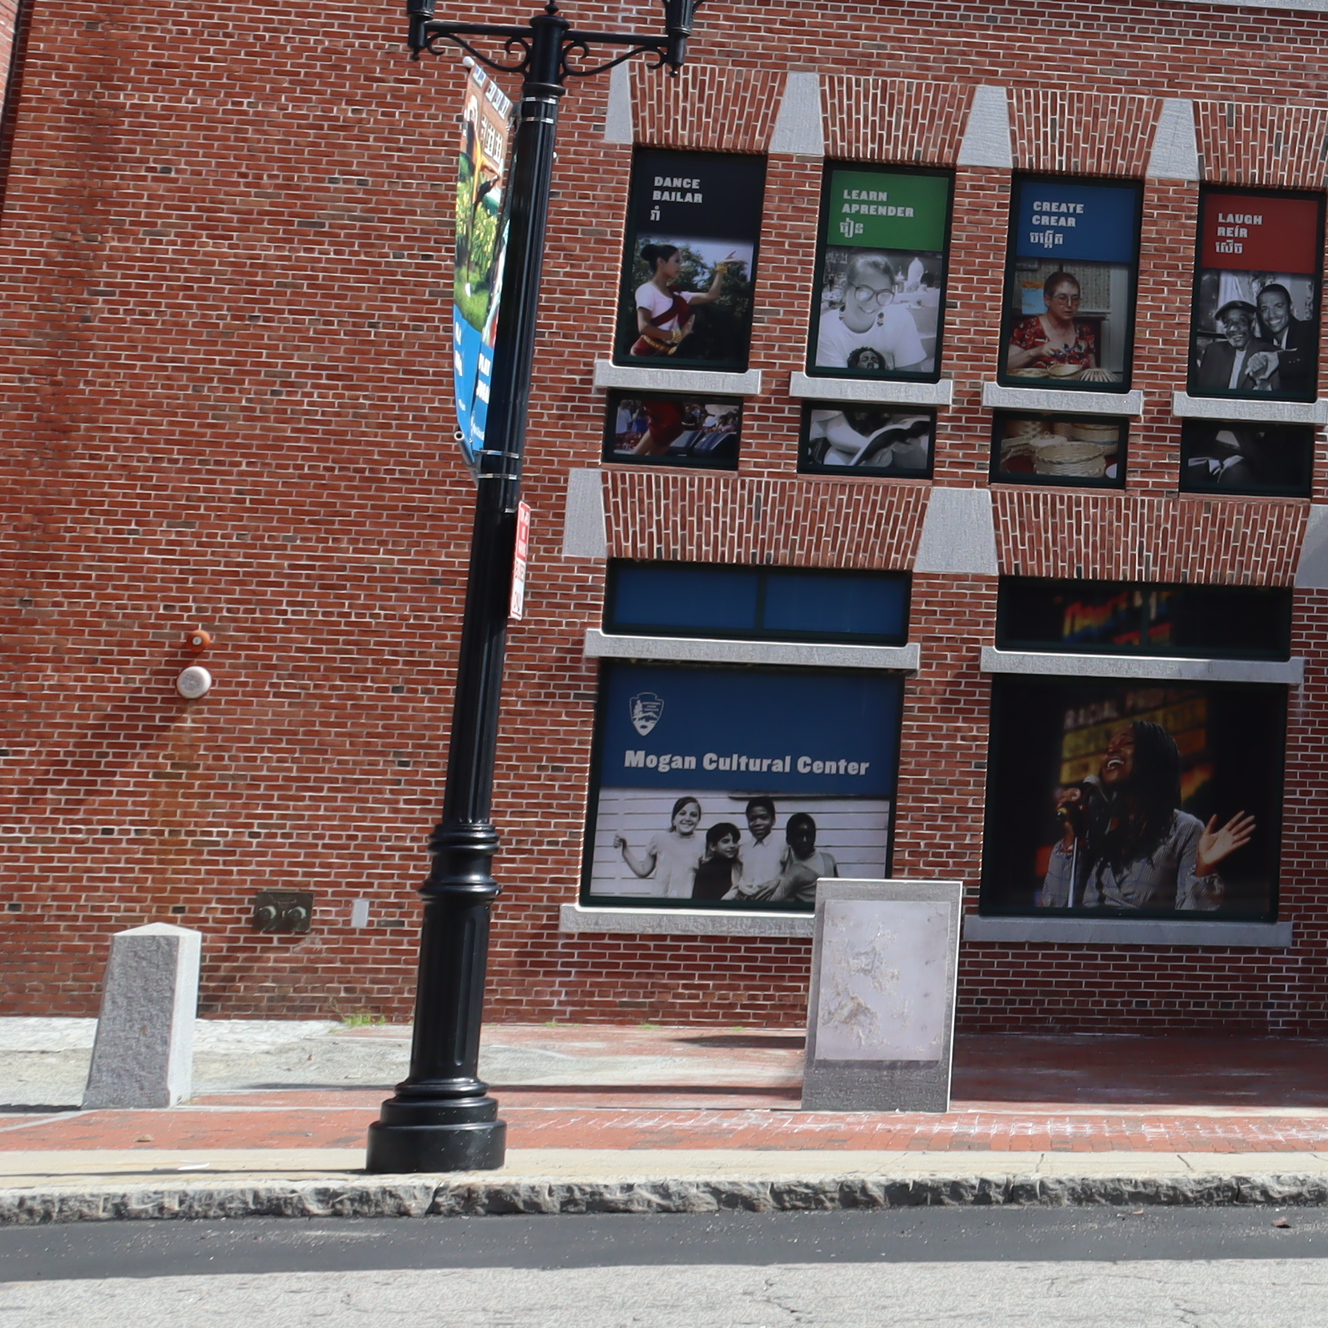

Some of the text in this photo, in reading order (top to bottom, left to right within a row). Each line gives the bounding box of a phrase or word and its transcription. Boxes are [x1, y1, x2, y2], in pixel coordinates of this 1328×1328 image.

[654, 176, 700, 189] DANCE
[652, 190, 703, 203] BAILAR
[843, 189, 888, 202] LEARN
[841, 203, 914, 217] APRENDER
[1032, 201, 1085, 214] CREATE
[1031, 215, 1076, 227] CREAR
[1218, 213, 1263, 225] LAUGH
[1217, 225, 1248, 238] REÍR
[624, 750, 870, 776] Mogan Cultural Center
